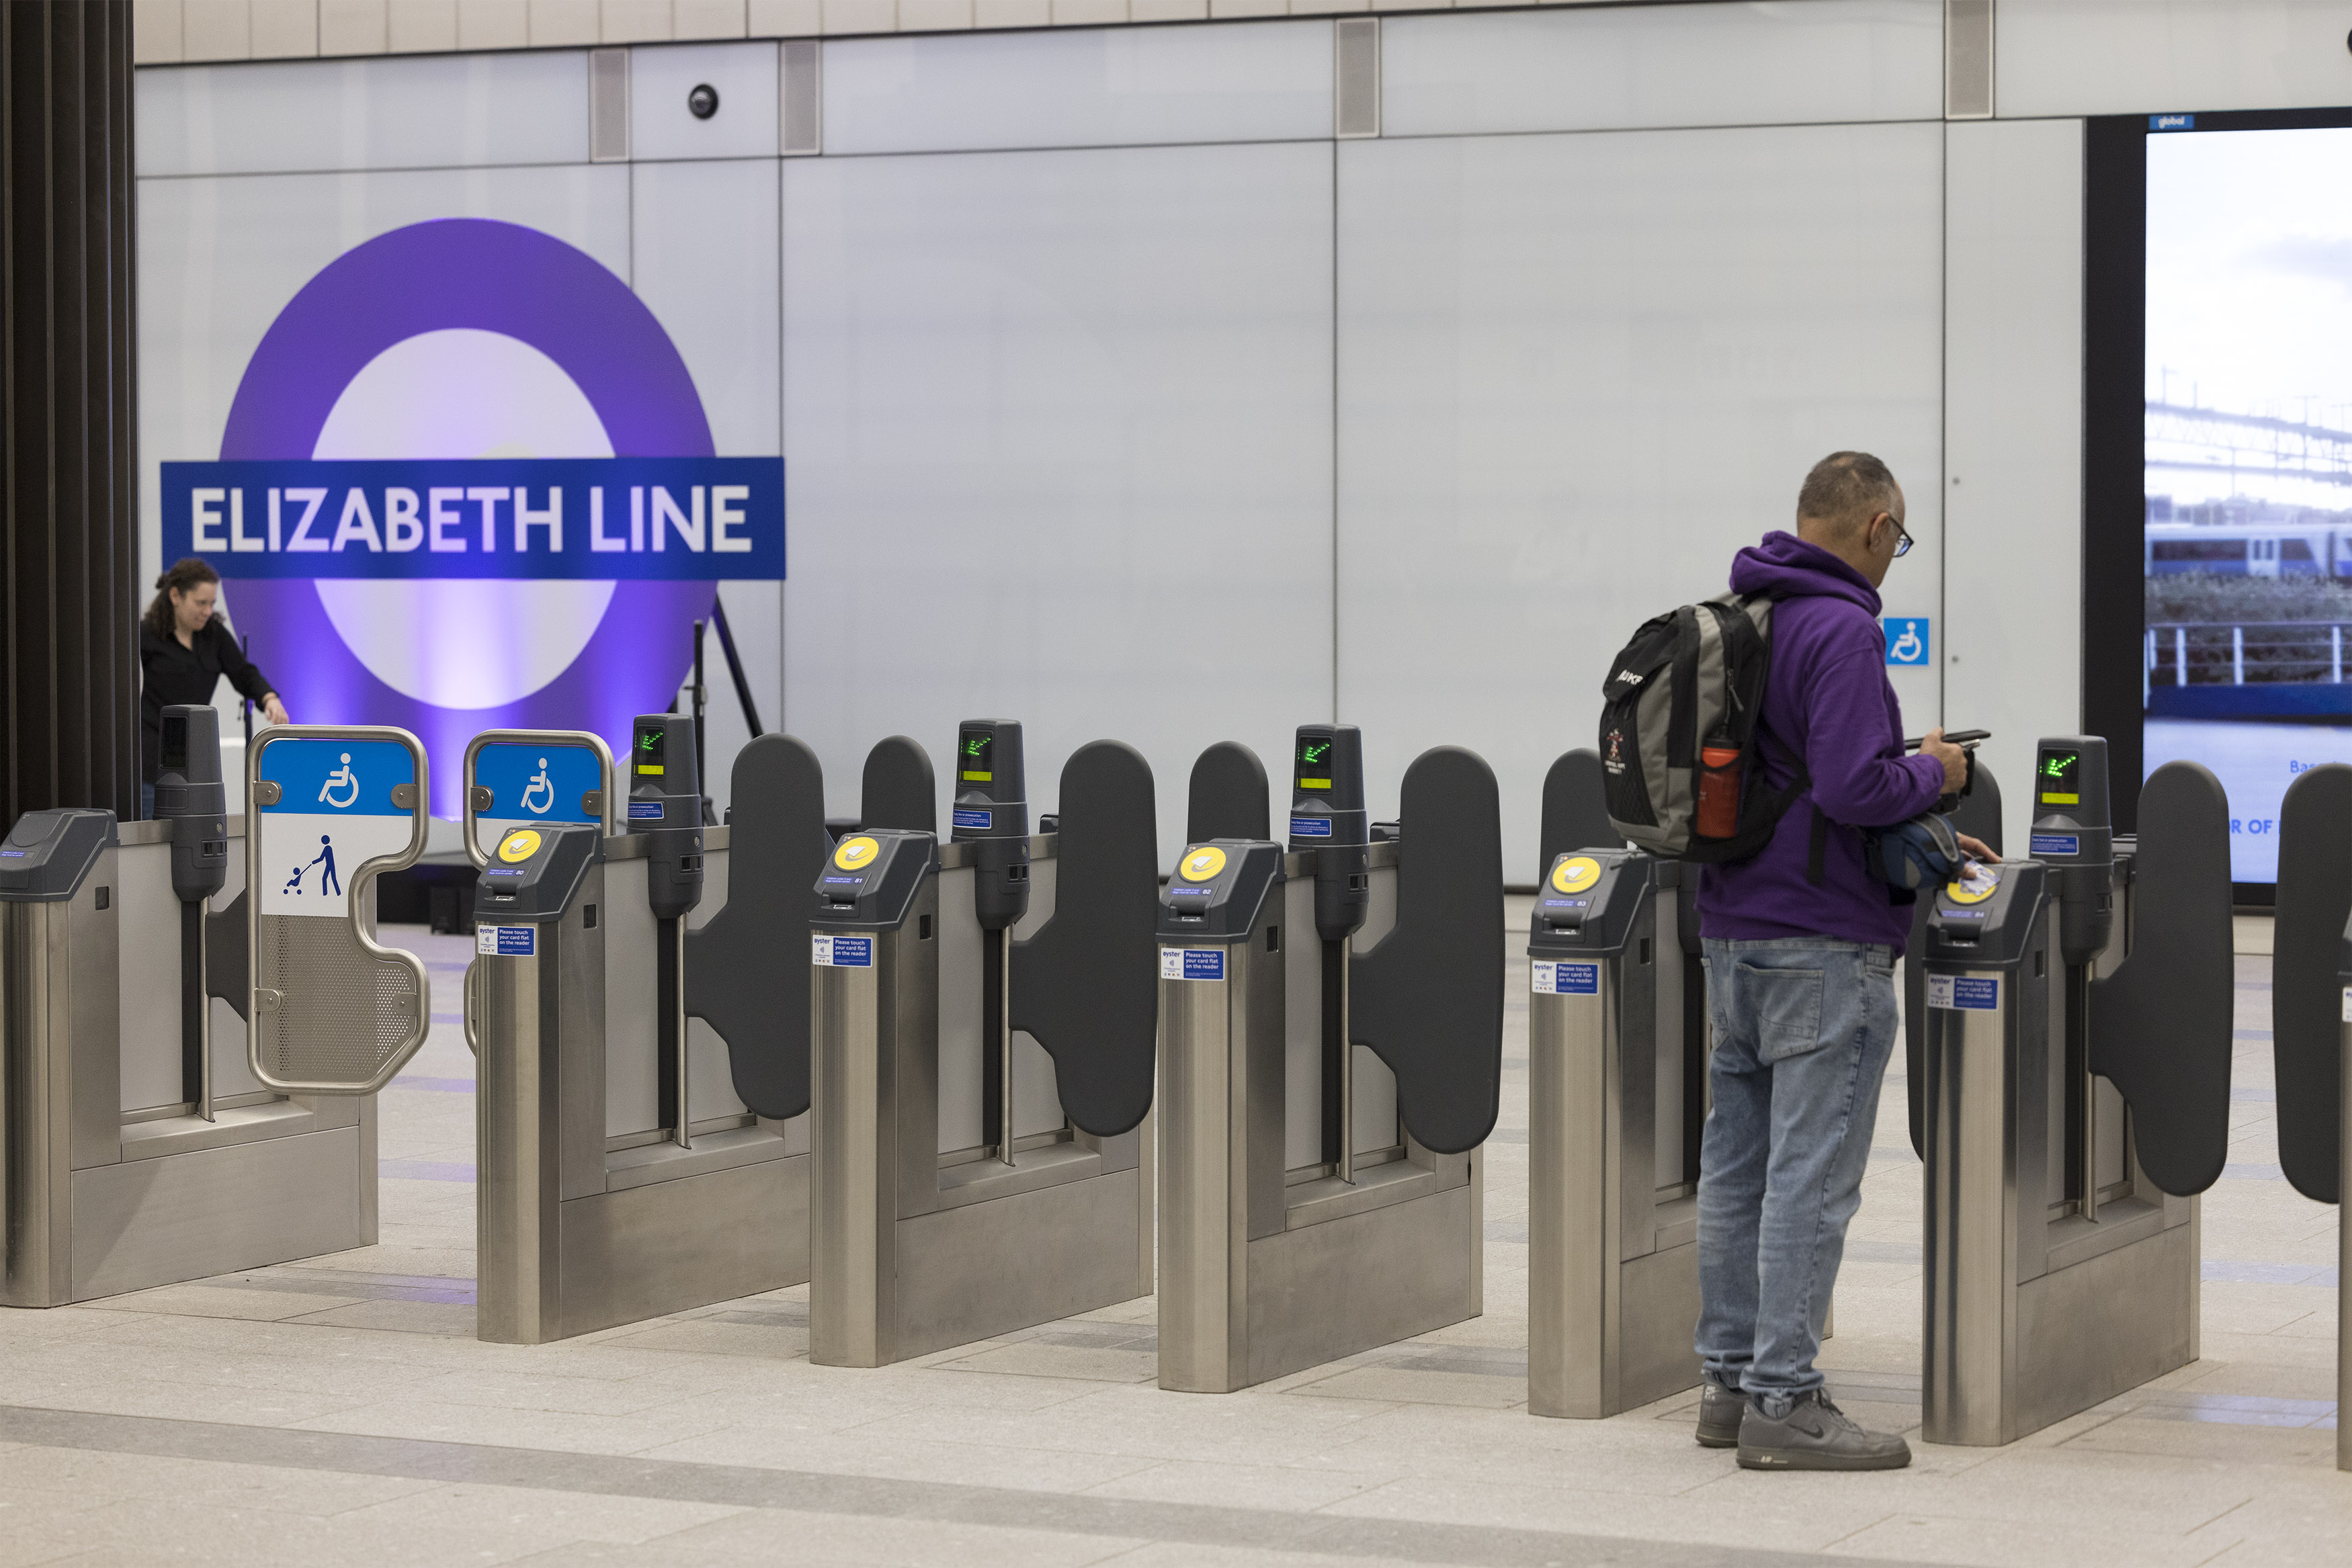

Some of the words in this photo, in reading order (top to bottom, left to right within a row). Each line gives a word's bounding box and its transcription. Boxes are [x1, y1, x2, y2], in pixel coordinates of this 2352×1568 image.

[191, 485, 563, 554] ELIZABETH
[589, 485, 753, 554] LINE
[2249, 820, 2272, 834] OF
